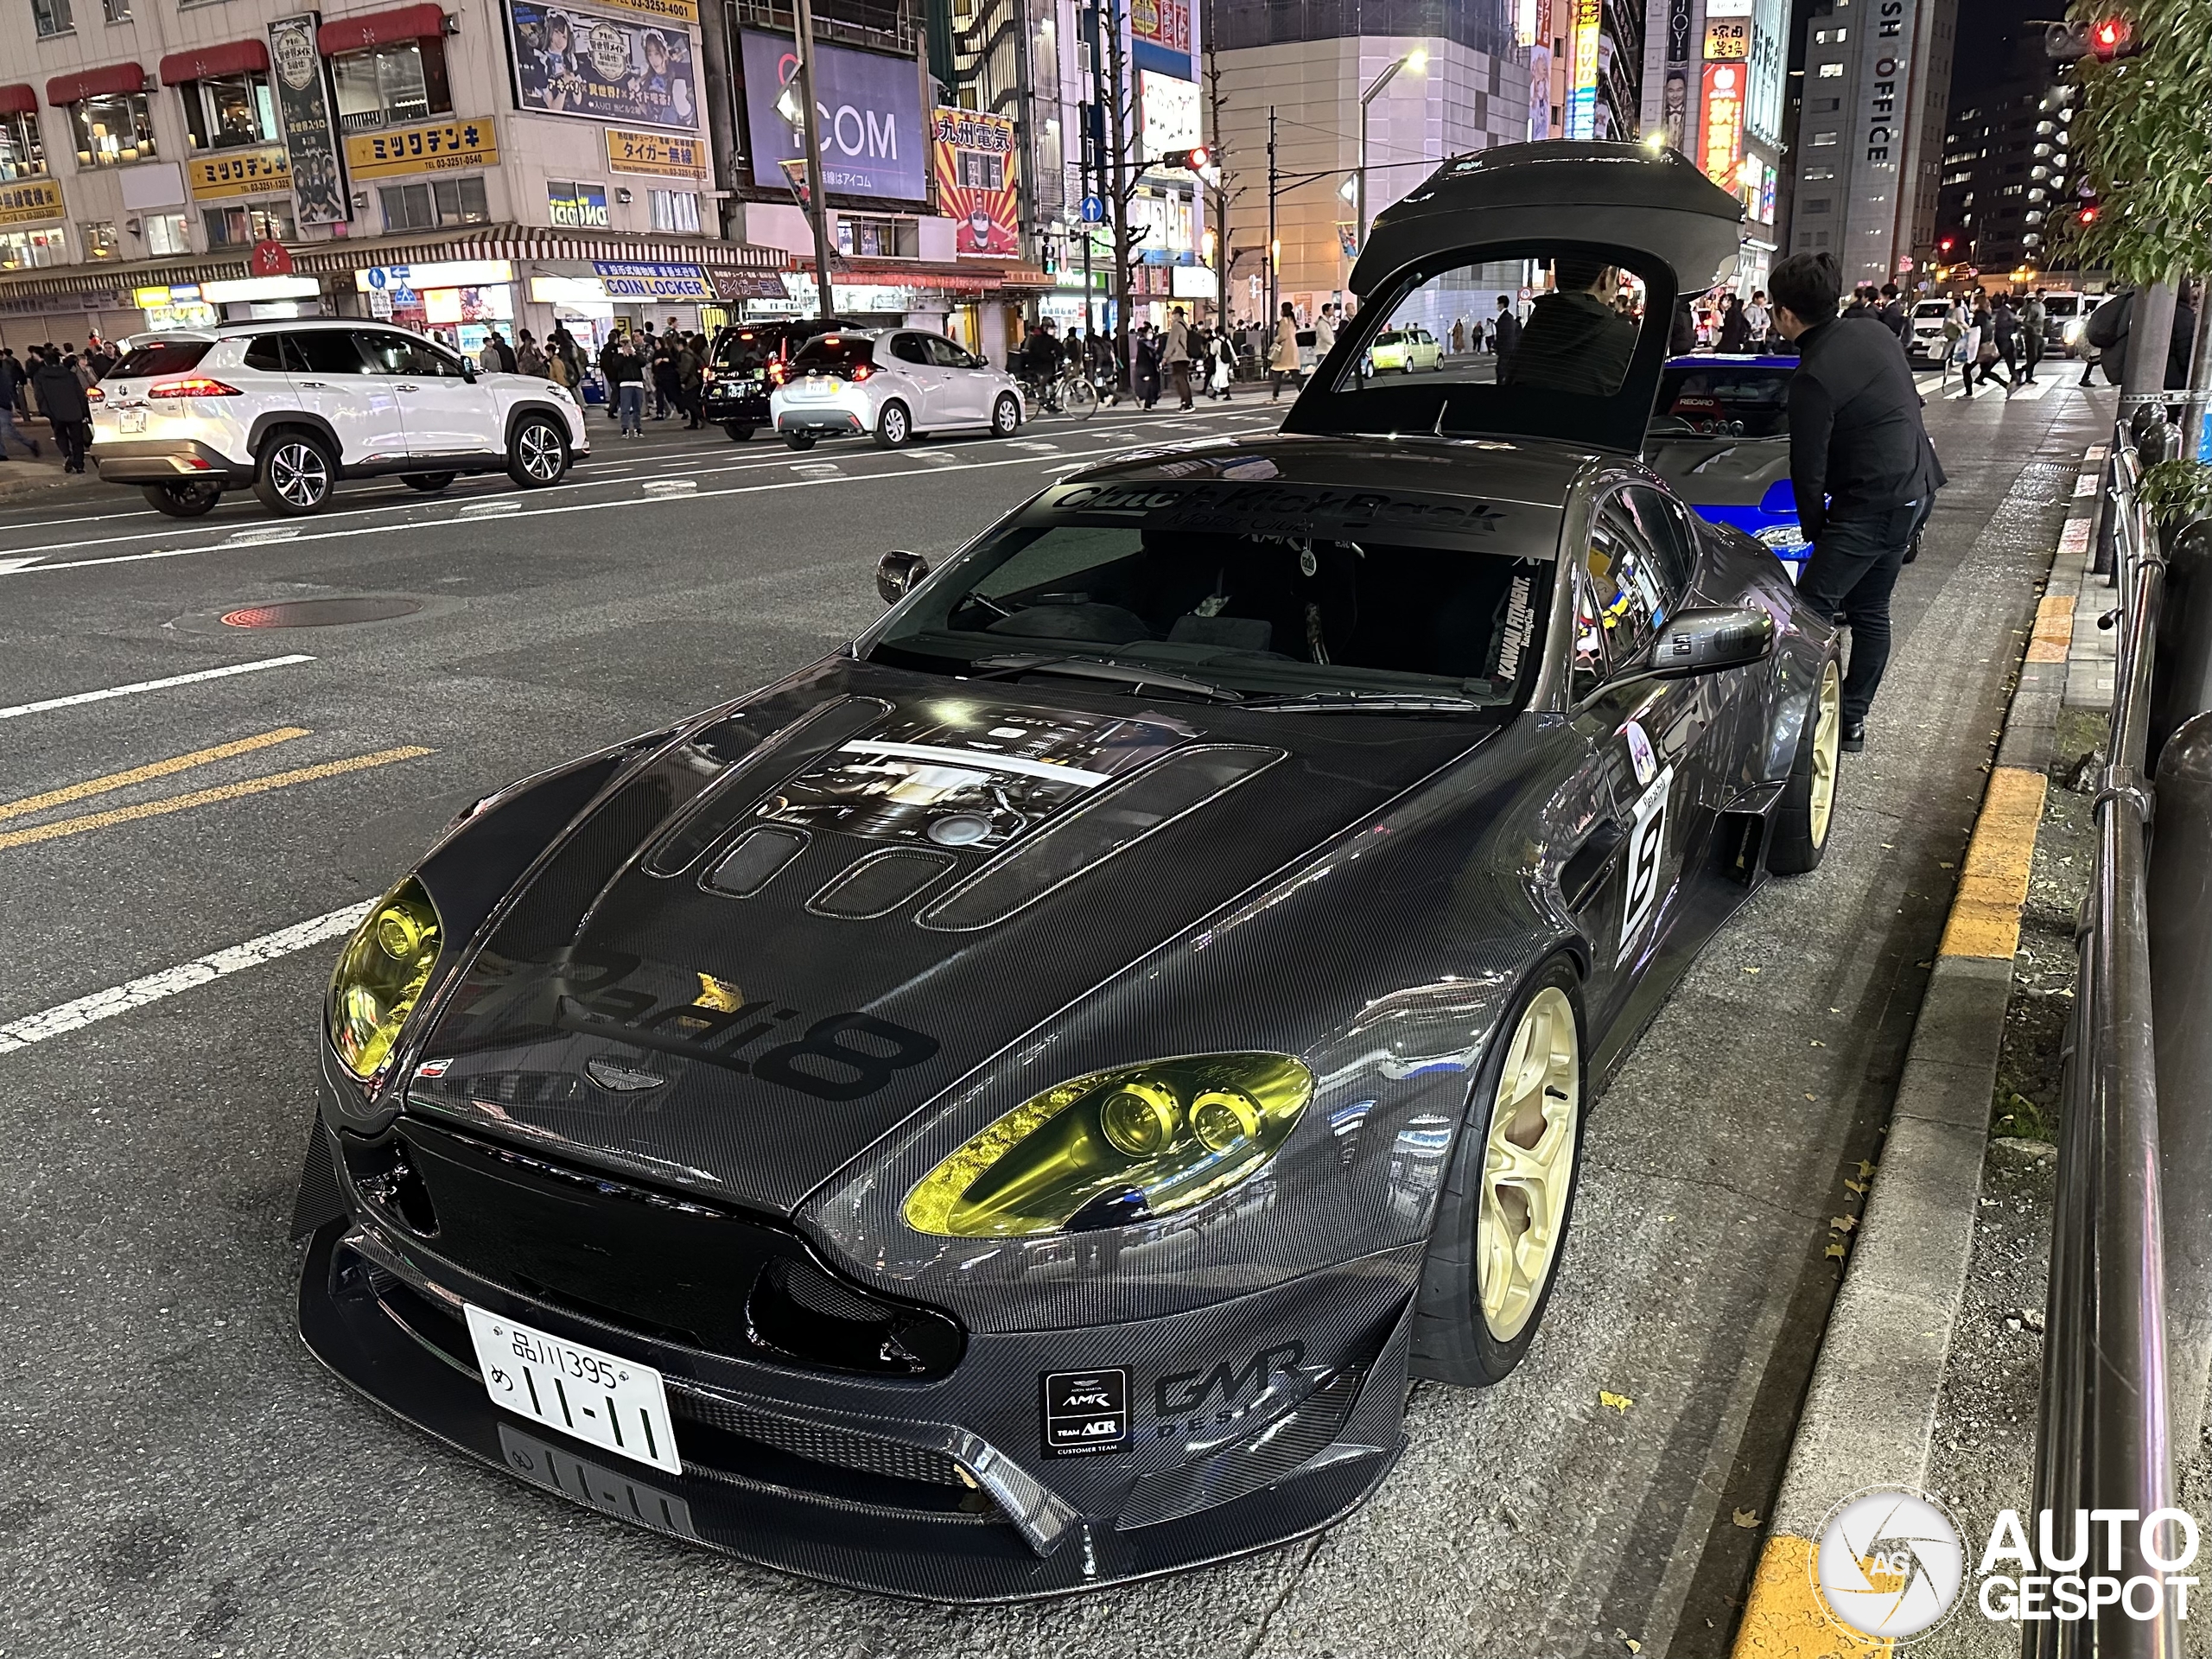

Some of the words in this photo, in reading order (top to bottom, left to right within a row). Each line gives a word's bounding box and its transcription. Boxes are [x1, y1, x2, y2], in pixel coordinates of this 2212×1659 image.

[1866, 57, 1897, 161] OFFICE
[372, 125, 480, 160] ミツワデンキ
[938, 118, 1012, 152] 九州電気
[425, 162, 435, 170] TEL
[436, 154, 482, 168] 03-3251-0540
[624, 142, 693, 165] タイガー無線
[204, 155, 288, 182] ミツワデンキ
[251, 179, 290, 192] 03-3251-1325
[606, 279, 646, 295] COIN
[645, 278, 706, 296] LOCKER
[719, 278, 785, 296] タイガー無線
[1679, 397, 1714, 407] RECARO
[1497, 626, 1523, 681] KAWAII
[1154, 1338, 1306, 1419] GMR
[1062, 1393, 1111, 1407] AMR
[491, 1363, 514, 1392] め
[523, 1365, 659, 1460] 11-11
[1081, 1421, 1117, 1436] ACR
[1058, 1446, 1097, 1455] CUSTOMER
